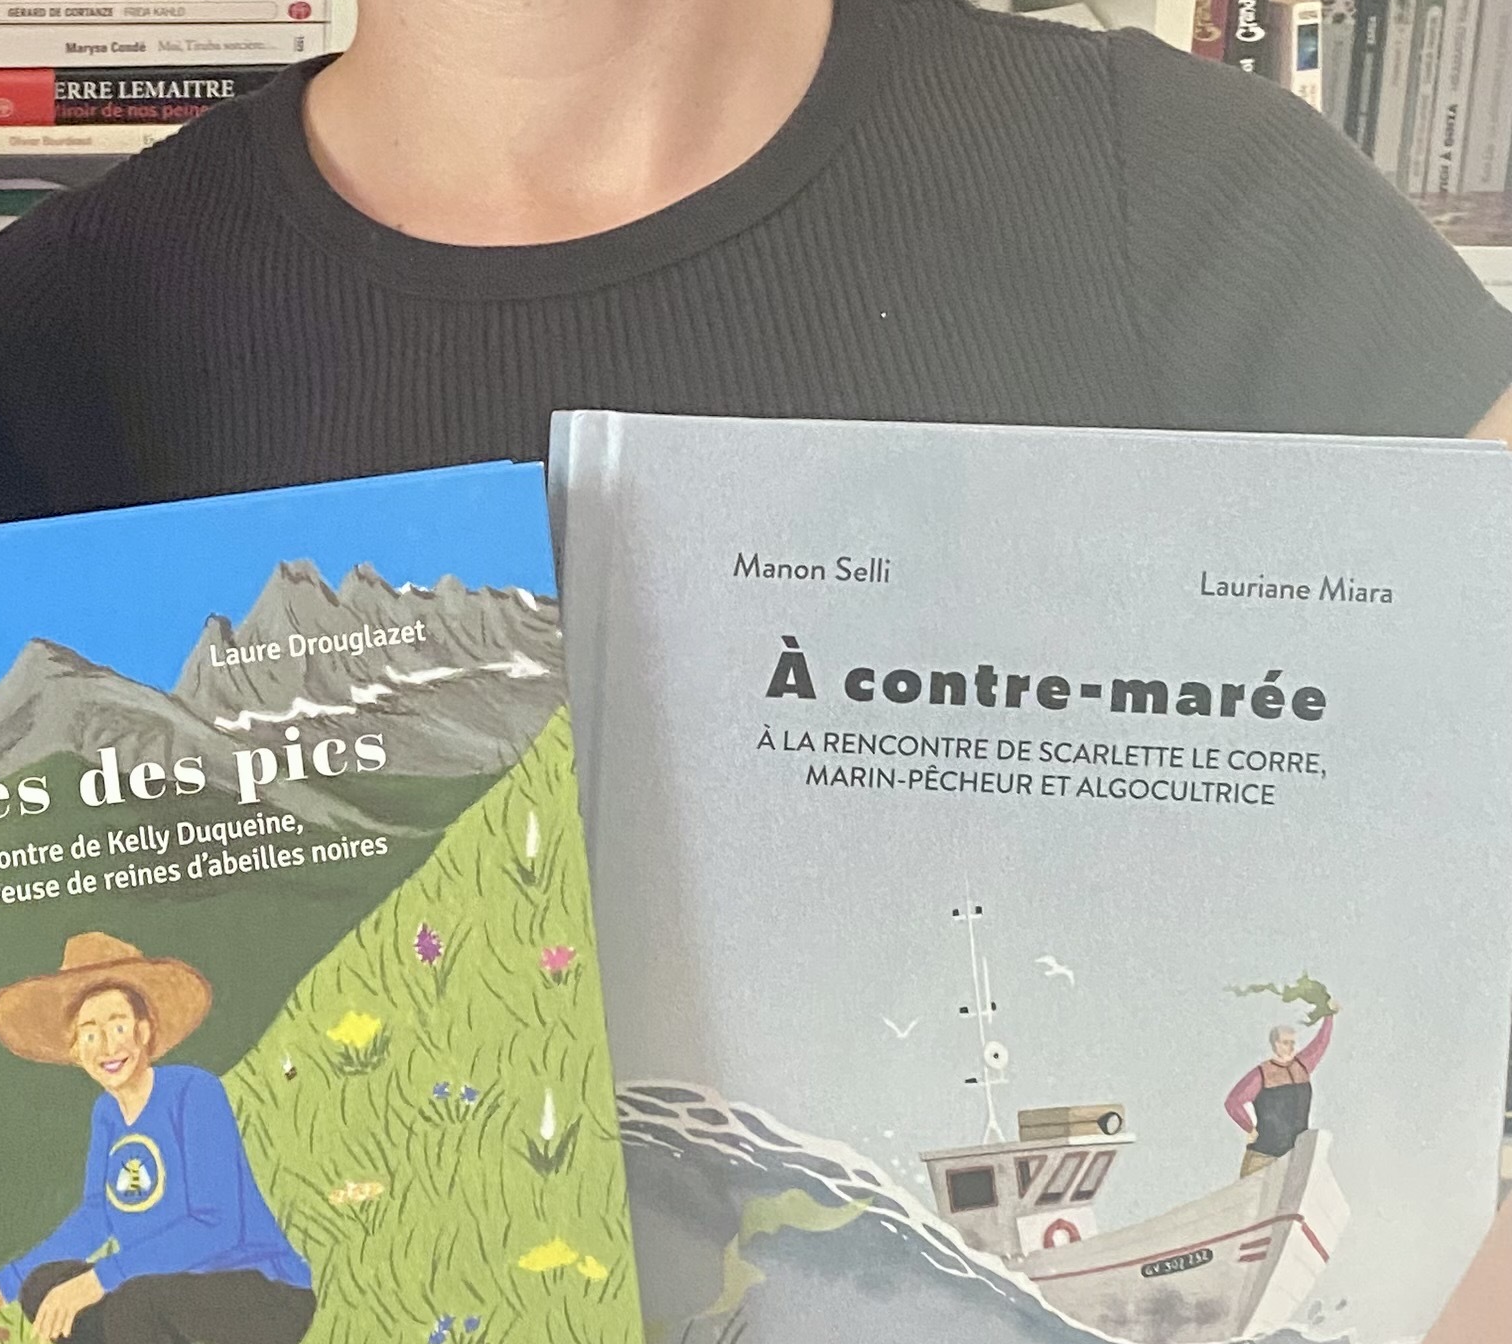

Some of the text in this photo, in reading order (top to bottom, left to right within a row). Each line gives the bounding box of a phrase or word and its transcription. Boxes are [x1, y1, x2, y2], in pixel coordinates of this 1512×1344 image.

[65, 40, 147, 56] Maryse Condé
[54, 79, 236, 100] ERRE LEMAITRE
[101, 101, 123, 119] de
[127, 104, 157, 119] nos
[732, 552, 892, 585] Manon Selli
[1199, 570, 1394, 605] Lauriane Miara
[209, 618, 427, 668] Laure Drouglazet
[765, 634, 1328, 722] À contre-marée
[79, 745, 207, 809] des
[233, 725, 389, 805] pics
[755, 723, 1328, 779] À LA RENCONTRE DE SCARLETTE LE CORRE,
[805, 763, 1277, 806] MARIN-PÊCHEUR ET ALGOCULTRICE
[70, 831, 102, 861] de
[107, 824, 172, 858] Kelly
[176, 810, 305, 850] Duqueine,
[66, 867, 98, 897] de
[103, 862, 182, 893] reines
[311, 836, 389, 867] noires
